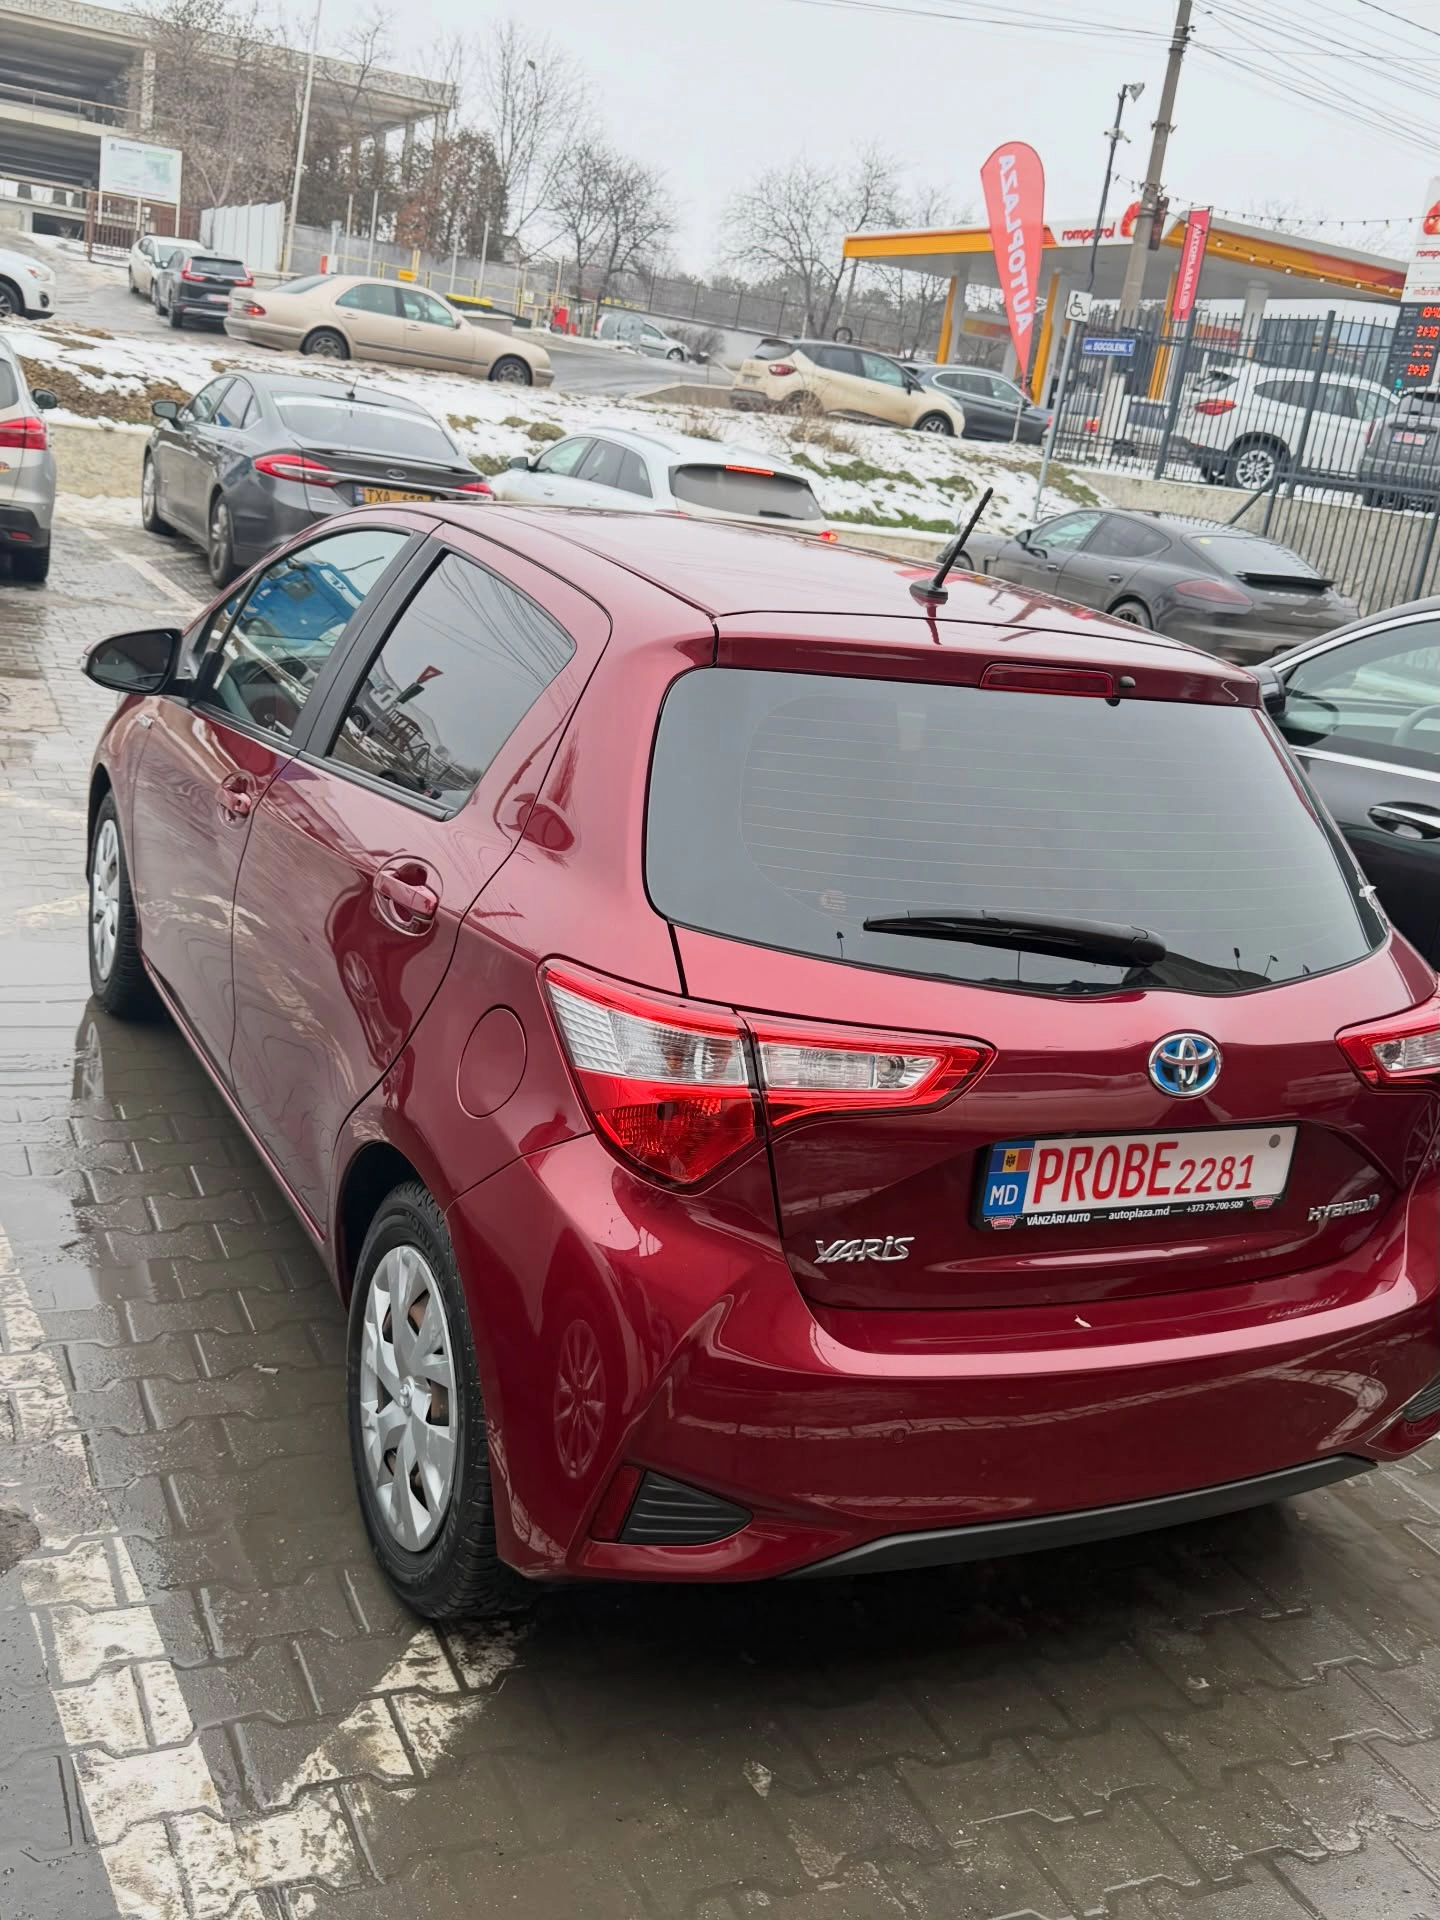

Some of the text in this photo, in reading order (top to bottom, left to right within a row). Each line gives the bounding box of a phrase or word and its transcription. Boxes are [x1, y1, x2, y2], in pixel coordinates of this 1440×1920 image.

[1033, 1141, 1254, 1204] PROBE 2281
[989, 1184, 1019, 1206] MD
[1065, 1212, 1091, 1224] AUTO
[1108, 1206, 1171, 1221] autoplaza.md
[1186, 1203, 1204, 1213] +373
